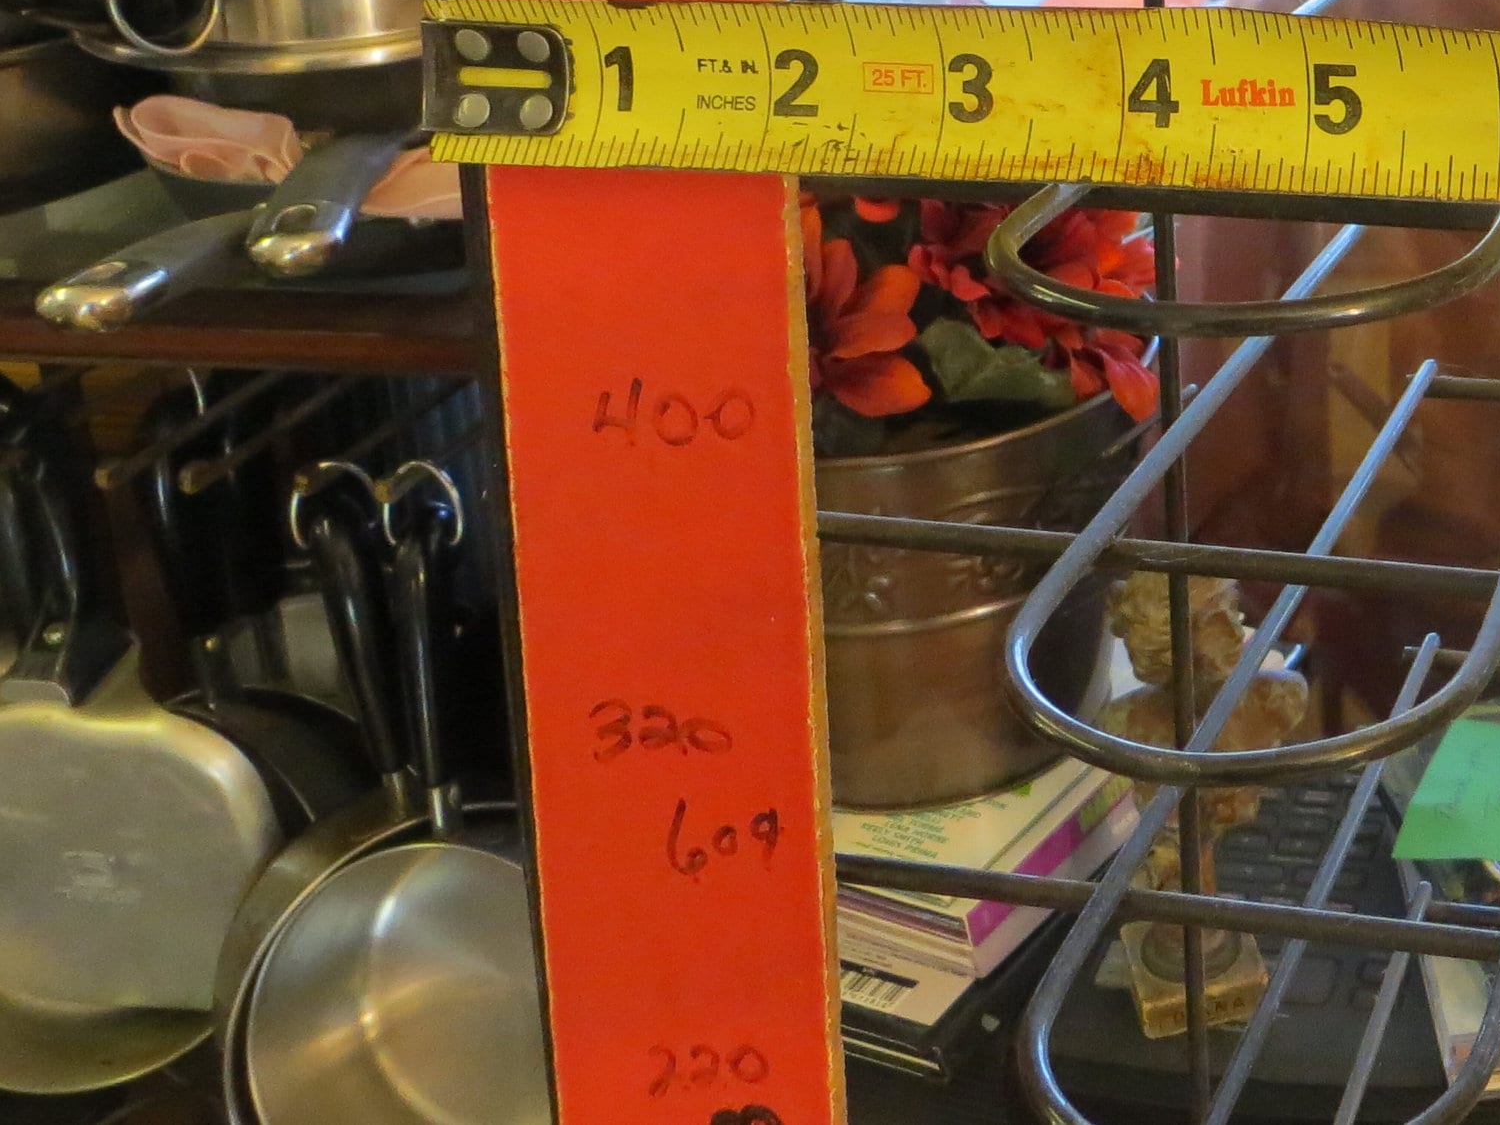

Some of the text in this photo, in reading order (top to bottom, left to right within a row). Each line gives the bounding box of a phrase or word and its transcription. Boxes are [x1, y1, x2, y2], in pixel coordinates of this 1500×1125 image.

[603, 45, 634, 111] 1
[696, 95, 756, 111] INCHES
[773, 49, 818, 117] 2
[872, 69, 927, 88] 25 FT.
[947, 53, 994, 124] 3
[1127, 58, 1180, 129] 4
[1201, 79, 1296, 107] Lufkin
[1312, 63, 1363, 135] 5
[592, 377, 757, 447] 400
[588, 698, 733, 763] 320
[649, 1043, 770, 1097] 220
